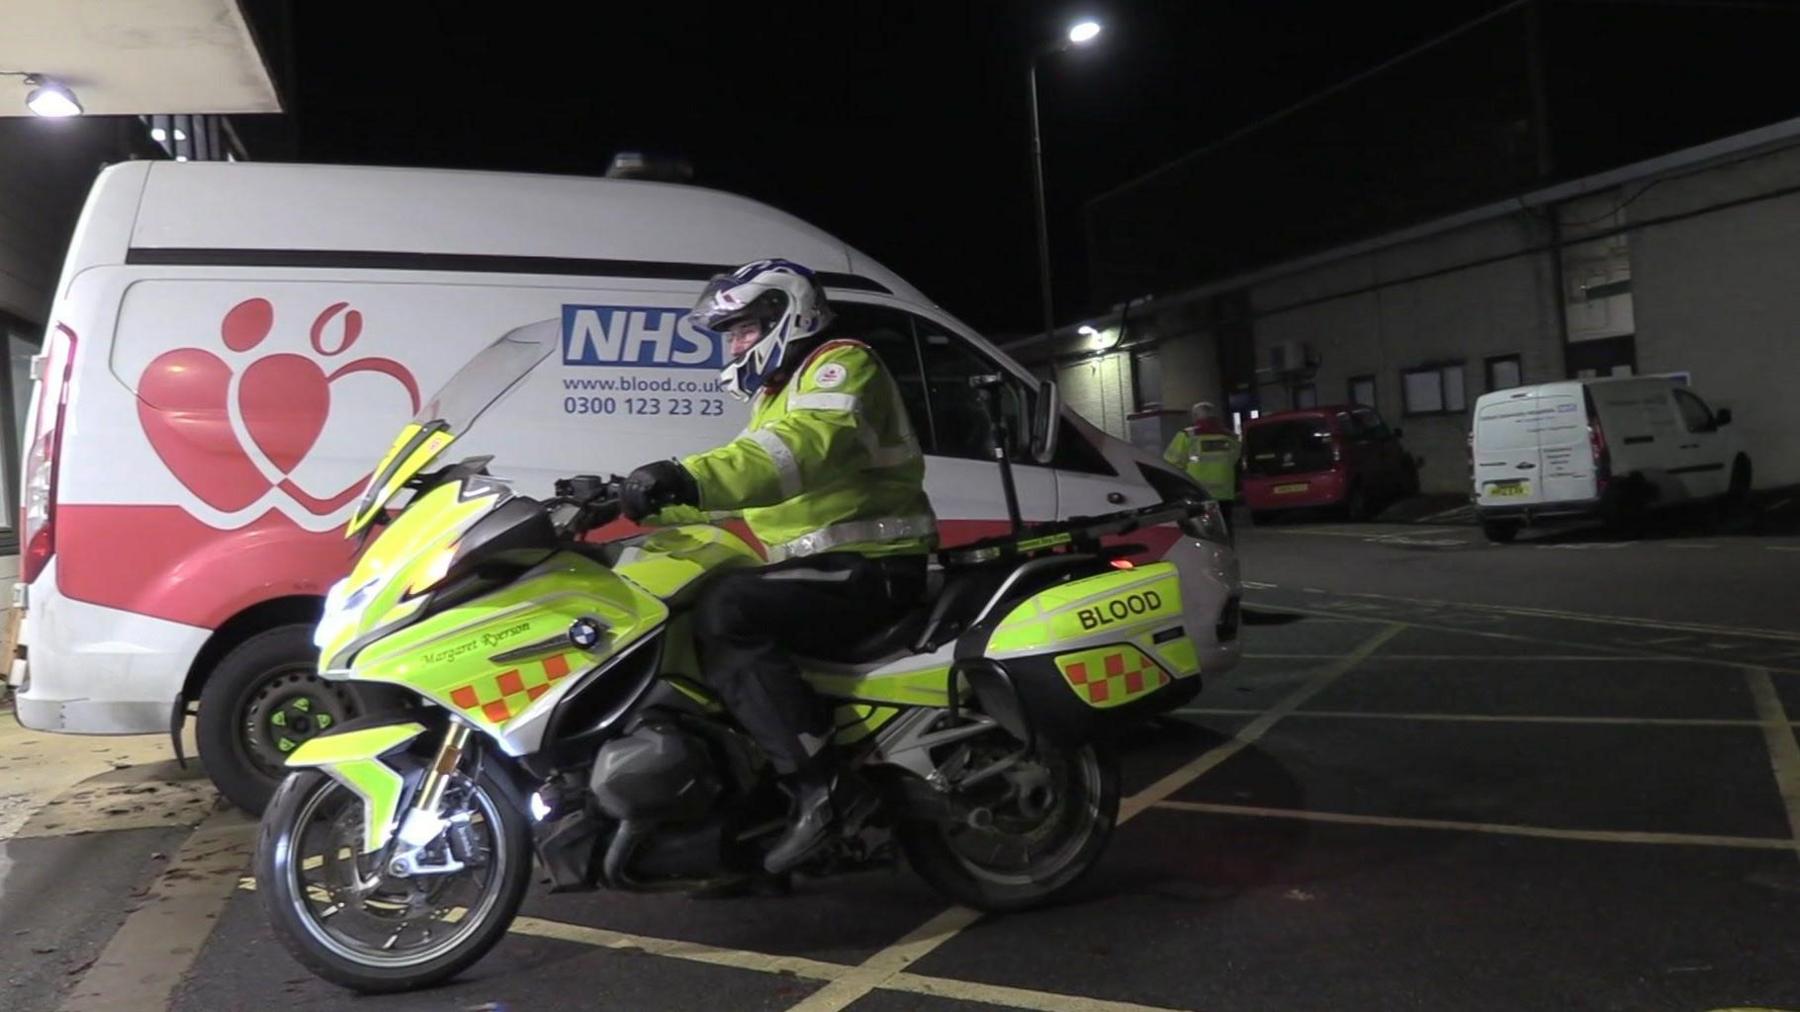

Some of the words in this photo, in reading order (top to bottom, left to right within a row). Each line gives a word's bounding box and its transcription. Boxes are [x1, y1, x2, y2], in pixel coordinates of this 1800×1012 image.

[567, 309, 713, 364] NHS
[563, 376, 724, 394] www.blood.co.uk
[564, 396, 616, 415] 0300
[625, 398, 661, 415] 123
[668, 399, 693, 416] 23
[700, 400, 724, 416] 23
[1077, 590, 1162, 630] BLOOD
[422, 640, 478, 663] Margaret
[481, 622, 531, 647] Ryerson
